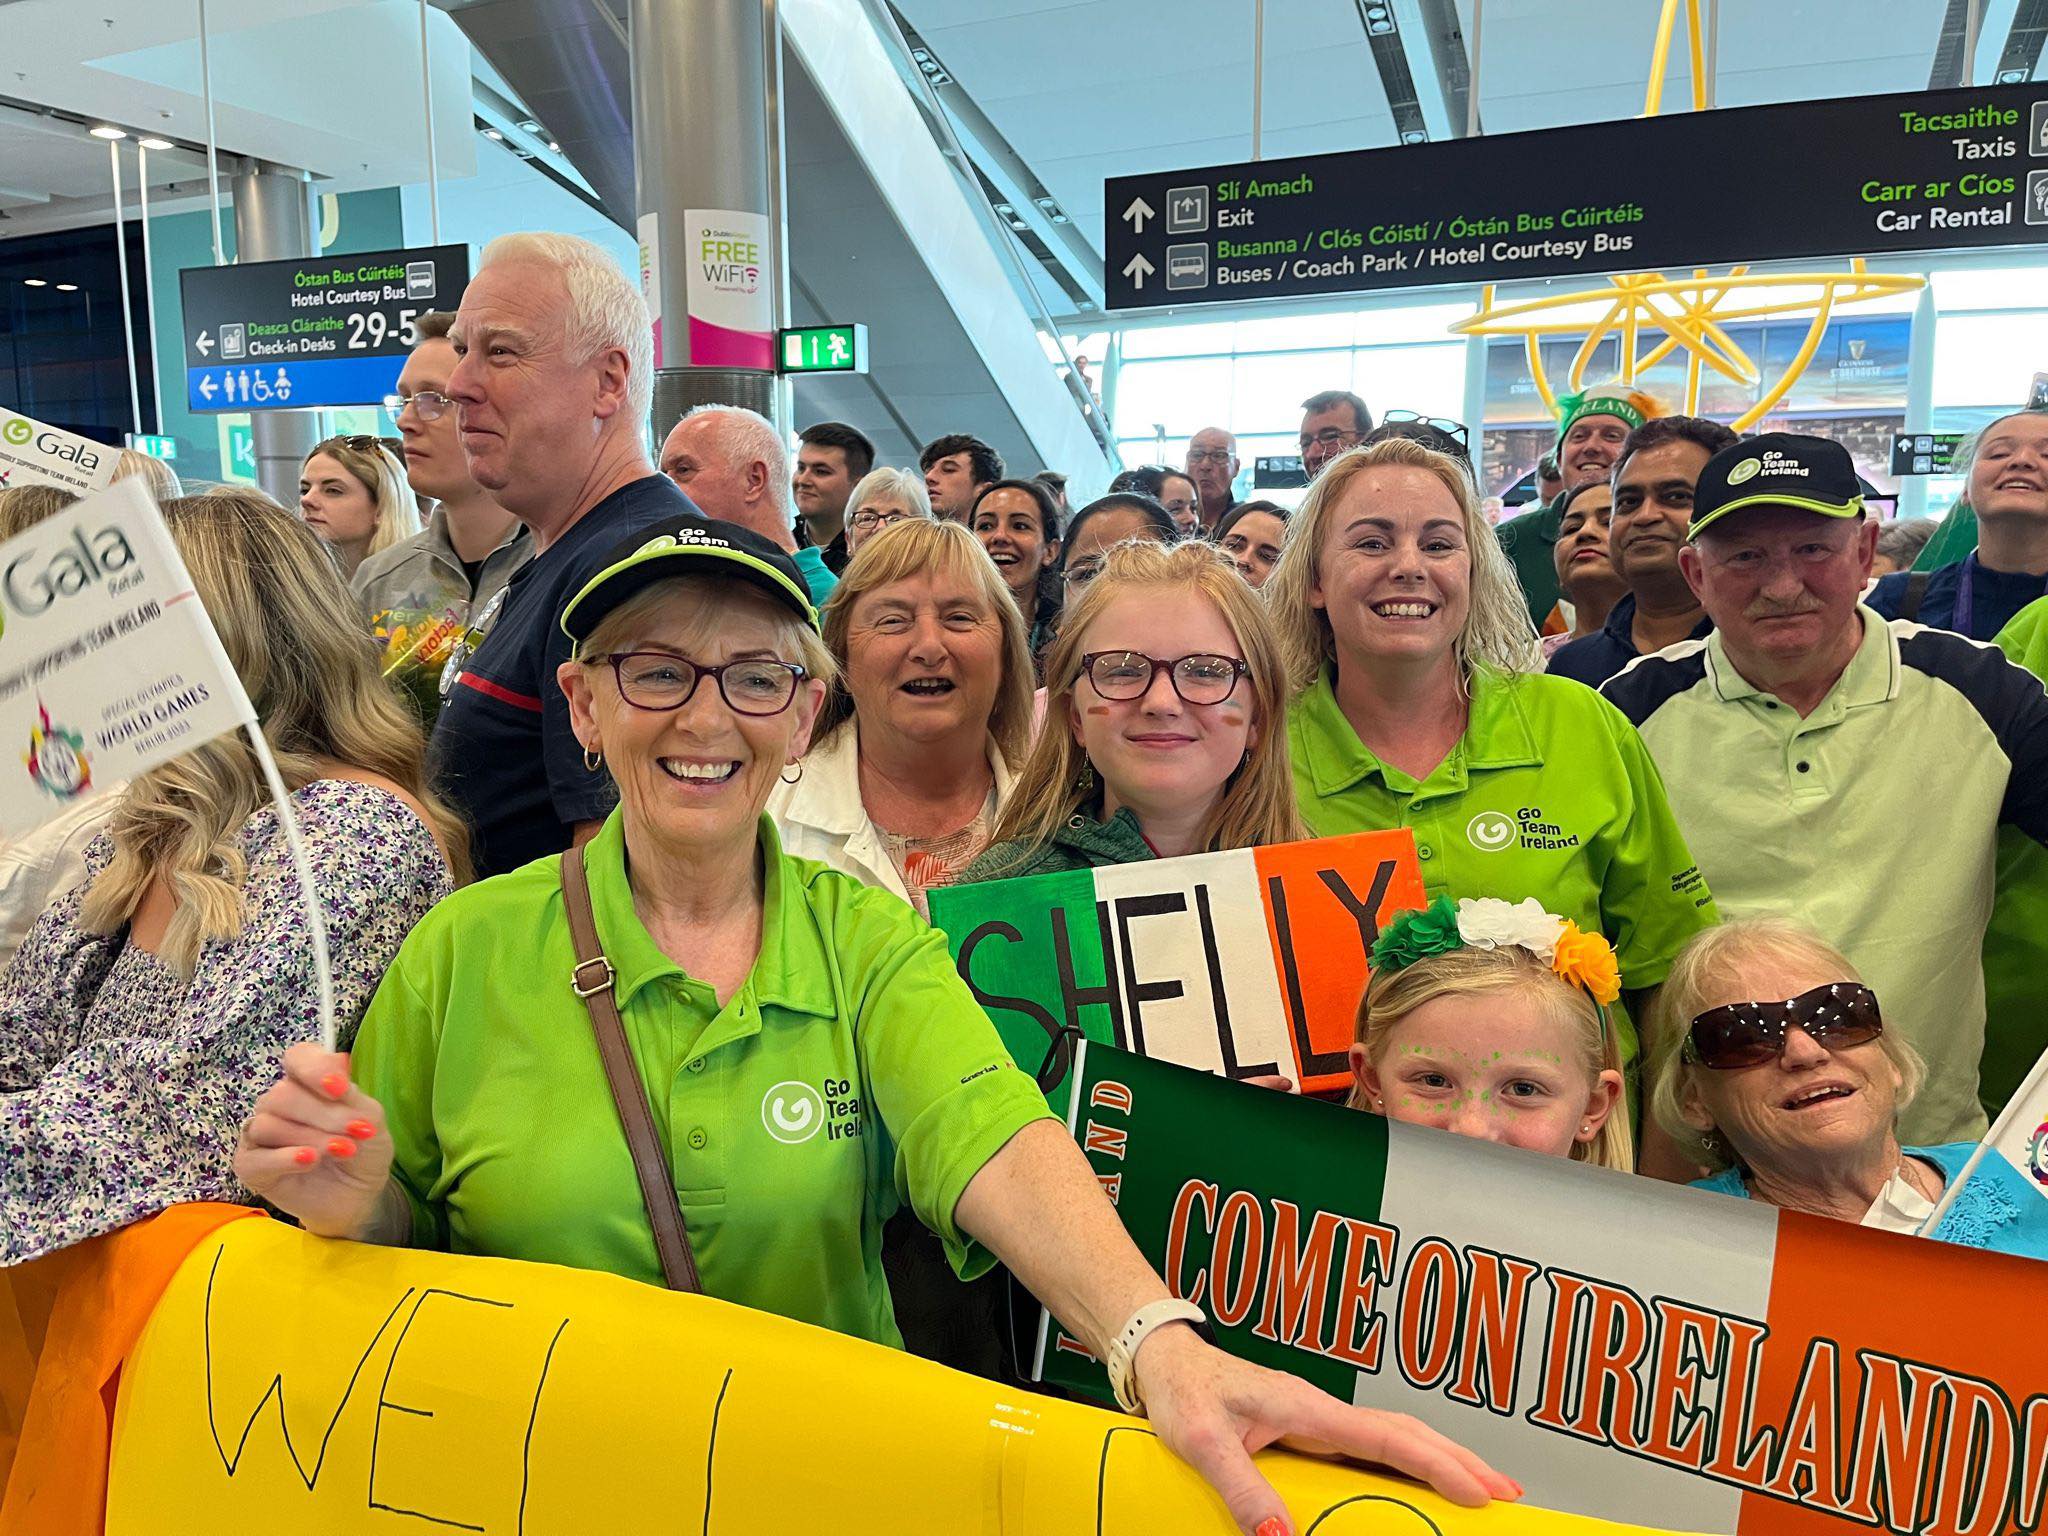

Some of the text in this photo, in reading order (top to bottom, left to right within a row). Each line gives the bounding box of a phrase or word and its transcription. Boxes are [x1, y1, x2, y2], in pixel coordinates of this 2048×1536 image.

[1899, 104, 2019, 134] Tacsaithe
[1952, 136, 2017, 160] Taxis
[1216, 174, 1313, 202] Slí Amach
[1861, 173, 2015, 203] Carr ar Cíos
[1217, 208, 1254, 228] Exit
[1876, 201, 2012, 232] Car Rental
[1217, 238, 1298, 259] Busanna
[1318, 224, 1362, 250] Clós
[1369, 221, 1429, 246] Cóistí
[1449, 215, 1509, 238] Óstán
[1516, 213, 1554, 232] Bus
[1560, 201, 1644, 228] Cúirtéis
[702, 240, 759, 265] FREE
[1217, 266, 1272, 285] Buses
[1292, 257, 1354, 279] Coach
[1362, 251, 1407, 273] Park
[1430, 243, 1485, 267] Hotel
[1491, 237, 1587, 263] Courtesy
[1593, 233, 1633, 253] Bus
[333, 267, 355, 283] Bus
[703, 263, 744, 284] WiFi
[291, 286, 406, 308] Hotel Courtesy Bus
[248, 317, 344, 336] Deasca Cláraithe
[347, 308, 434, 350] 29-5
[249, 337, 336, 357] Check-in Desks
[36, 432, 99, 470] Gala
[1762, 451, 1783, 461] Go
[1760, 467, 1810, 477] Ireland
[1762, 459, 1799, 469] Team
[49, 470, 66, 482] TEAM
[64, 475, 89, 489] IRELAND
[679, 528, 706, 537] Go
[679, 535, 729, 547] Team
[2, 522, 136, 619] Gala
[116, 598, 162, 637] IRELAND
[94, 683, 210, 751] WORLD GAMES
[1517, 807, 1541, 820] Go
[1518, 820, 1561, 836] Team
[1520, 835, 1579, 850] Ireland
[956, 860, 1397, 1095] SHELLY
[824, 1078, 851, 1097] Go
[826, 1098, 862, 1119] Tea
[1164, 1178, 1399, 1373] COME
[1398, 1239, 1540, 1416] ON
